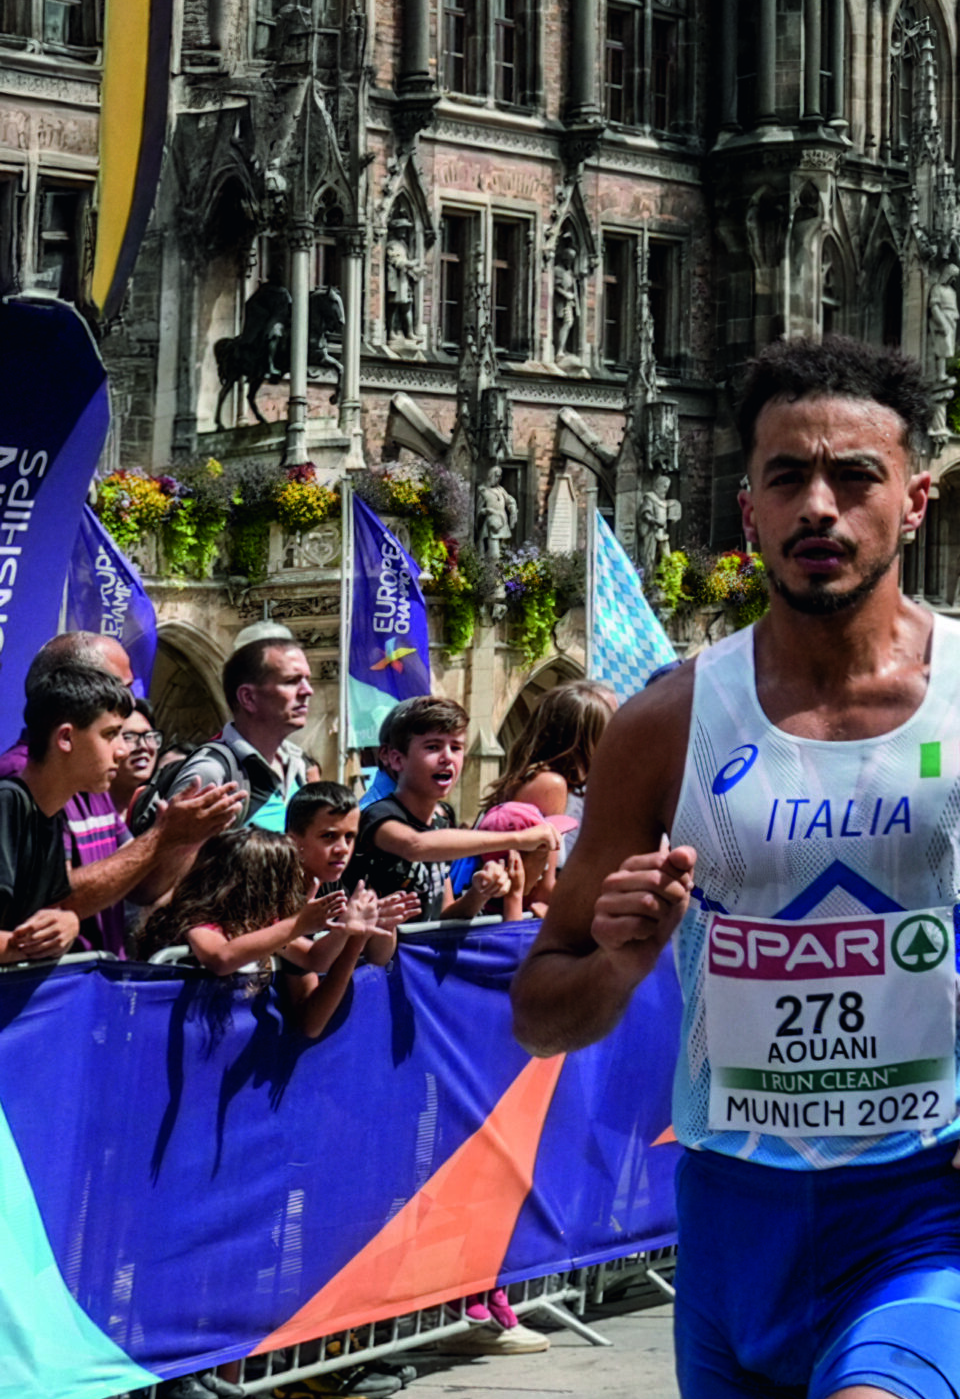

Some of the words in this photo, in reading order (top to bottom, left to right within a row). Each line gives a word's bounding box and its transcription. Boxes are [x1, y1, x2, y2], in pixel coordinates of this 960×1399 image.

[766, 796, 911, 842] ITALIA
[711, 924, 880, 971] SPAR
[775, 991, 865, 1037] 278
[768, 1036, 877, 1064] AOUANI
[762, 1073, 767, 1089] I
[772, 1073, 814, 1092] RUN
[727, 1096, 844, 1127] MUNICH
[858, 1090, 940, 1126] 2022
